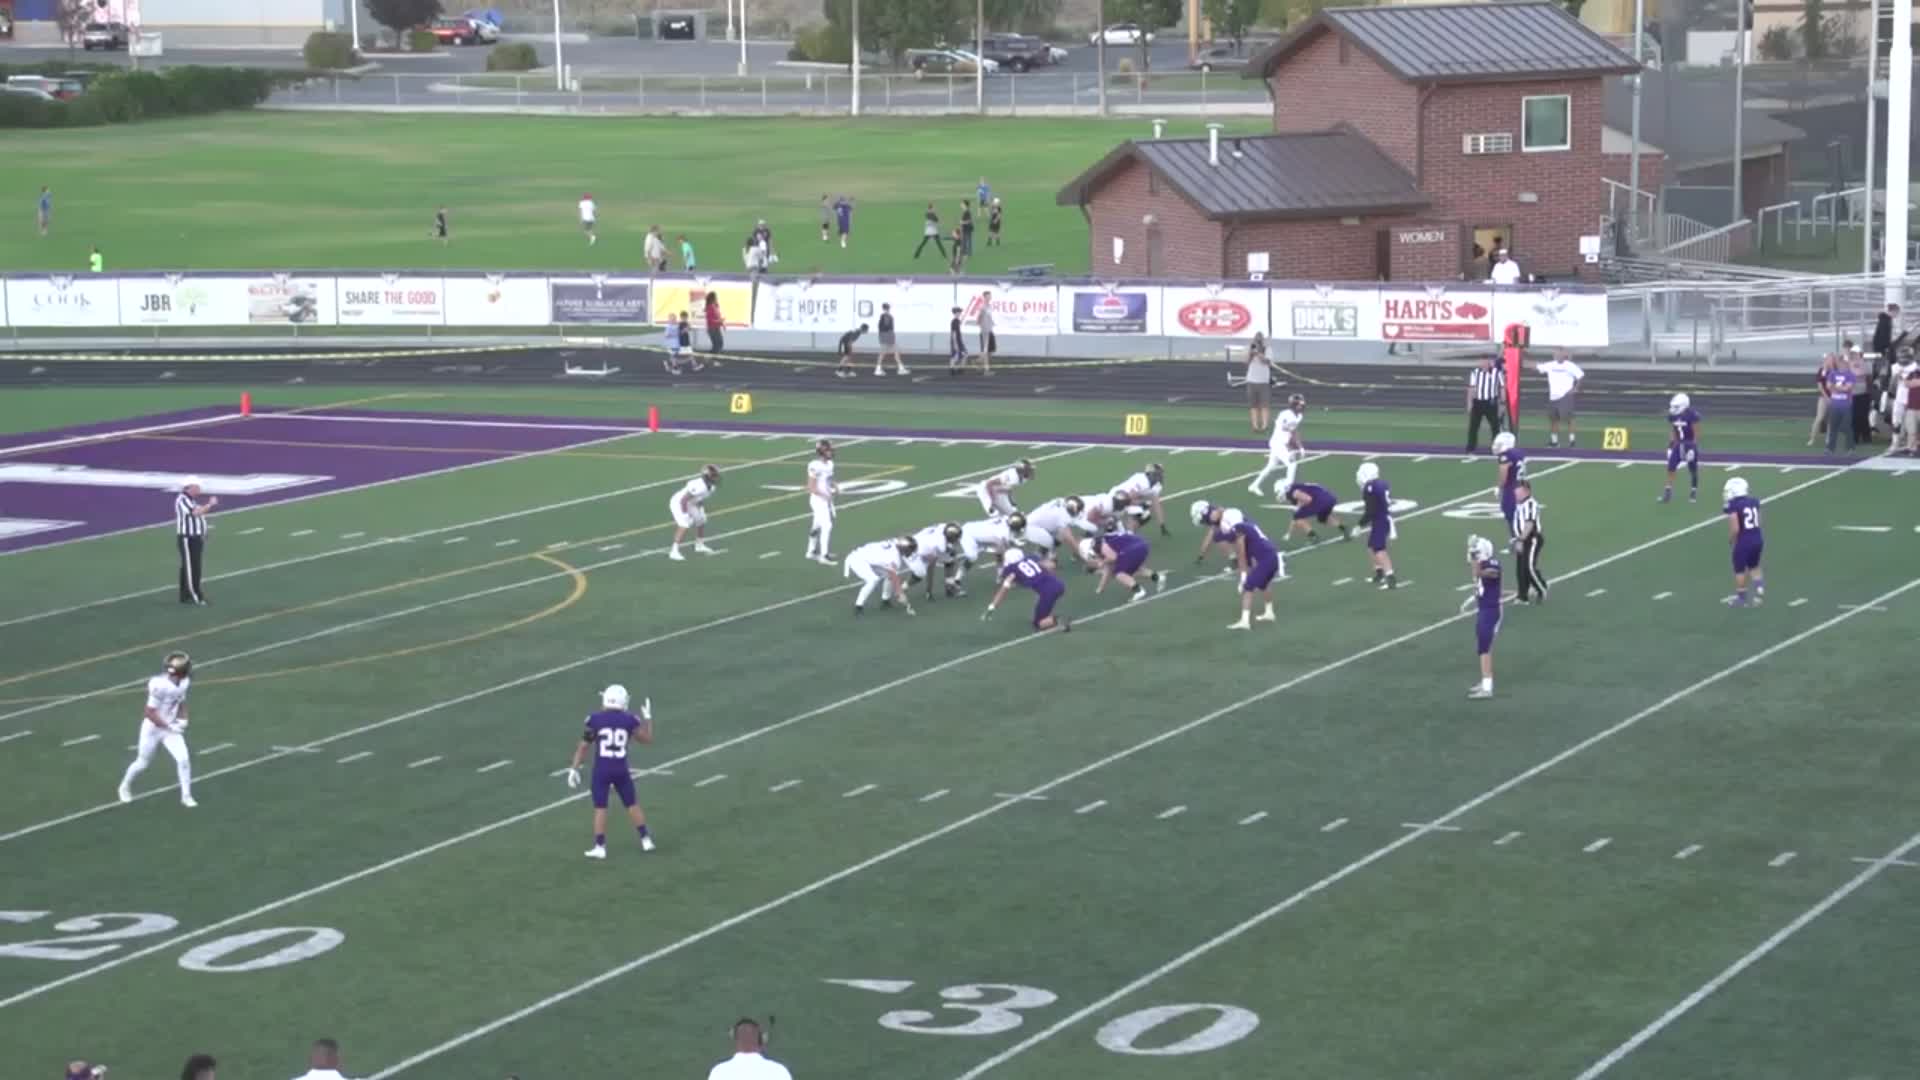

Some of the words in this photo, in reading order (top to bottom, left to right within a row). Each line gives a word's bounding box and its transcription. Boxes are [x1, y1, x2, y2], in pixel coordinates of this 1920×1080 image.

[1400, 231, 1445, 243] WOMEN
[140, 294, 171, 311] JBR
[345, 291, 380, 305] SHARE
[384, 291, 403, 305] THE
[407, 291, 436, 305] GOOD
[799, 298, 838, 315] HOYER
[992, 301, 1018, 313] RED
[1022, 301, 1057, 313] PINE
[1384, 299, 1453, 320] HARTS
[1294, 307, 1356, 329] DICK'S
[734, 395, 745, 410] G
[1130, 416, 1144, 433] 10
[1606, 430, 1623, 447] 20
[1743, 506, 1760, 529] 21
[1018, 558, 1043, 578] 81
[598, 727, 629, 759] 29
